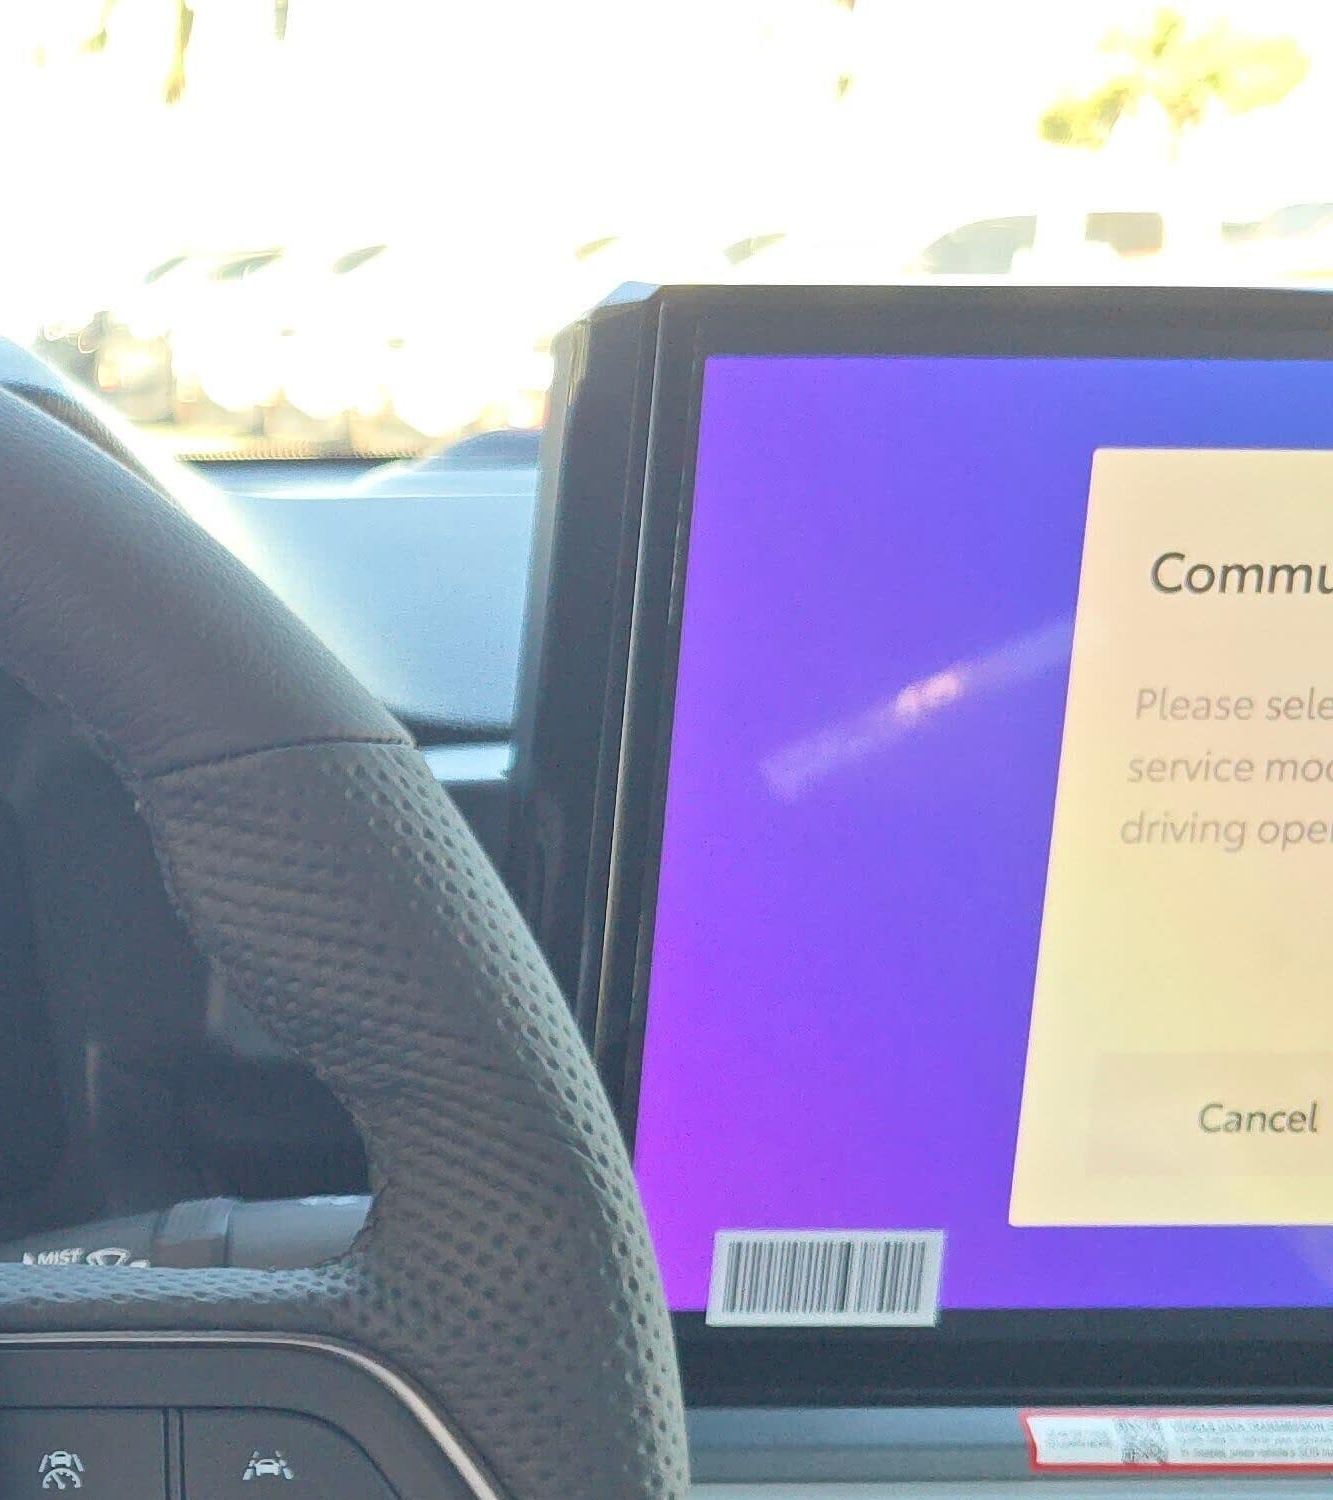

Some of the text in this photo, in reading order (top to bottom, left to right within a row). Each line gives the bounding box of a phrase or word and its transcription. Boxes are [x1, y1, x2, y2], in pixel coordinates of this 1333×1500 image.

[1135, 686, 1254, 721] Please
[1127, 750, 1254, 783] service
[1120, 811, 1333, 853] driving ope
[1198, 1100, 1318, 1133] Cancel
[37, 1247, 85, 1266] MIST
